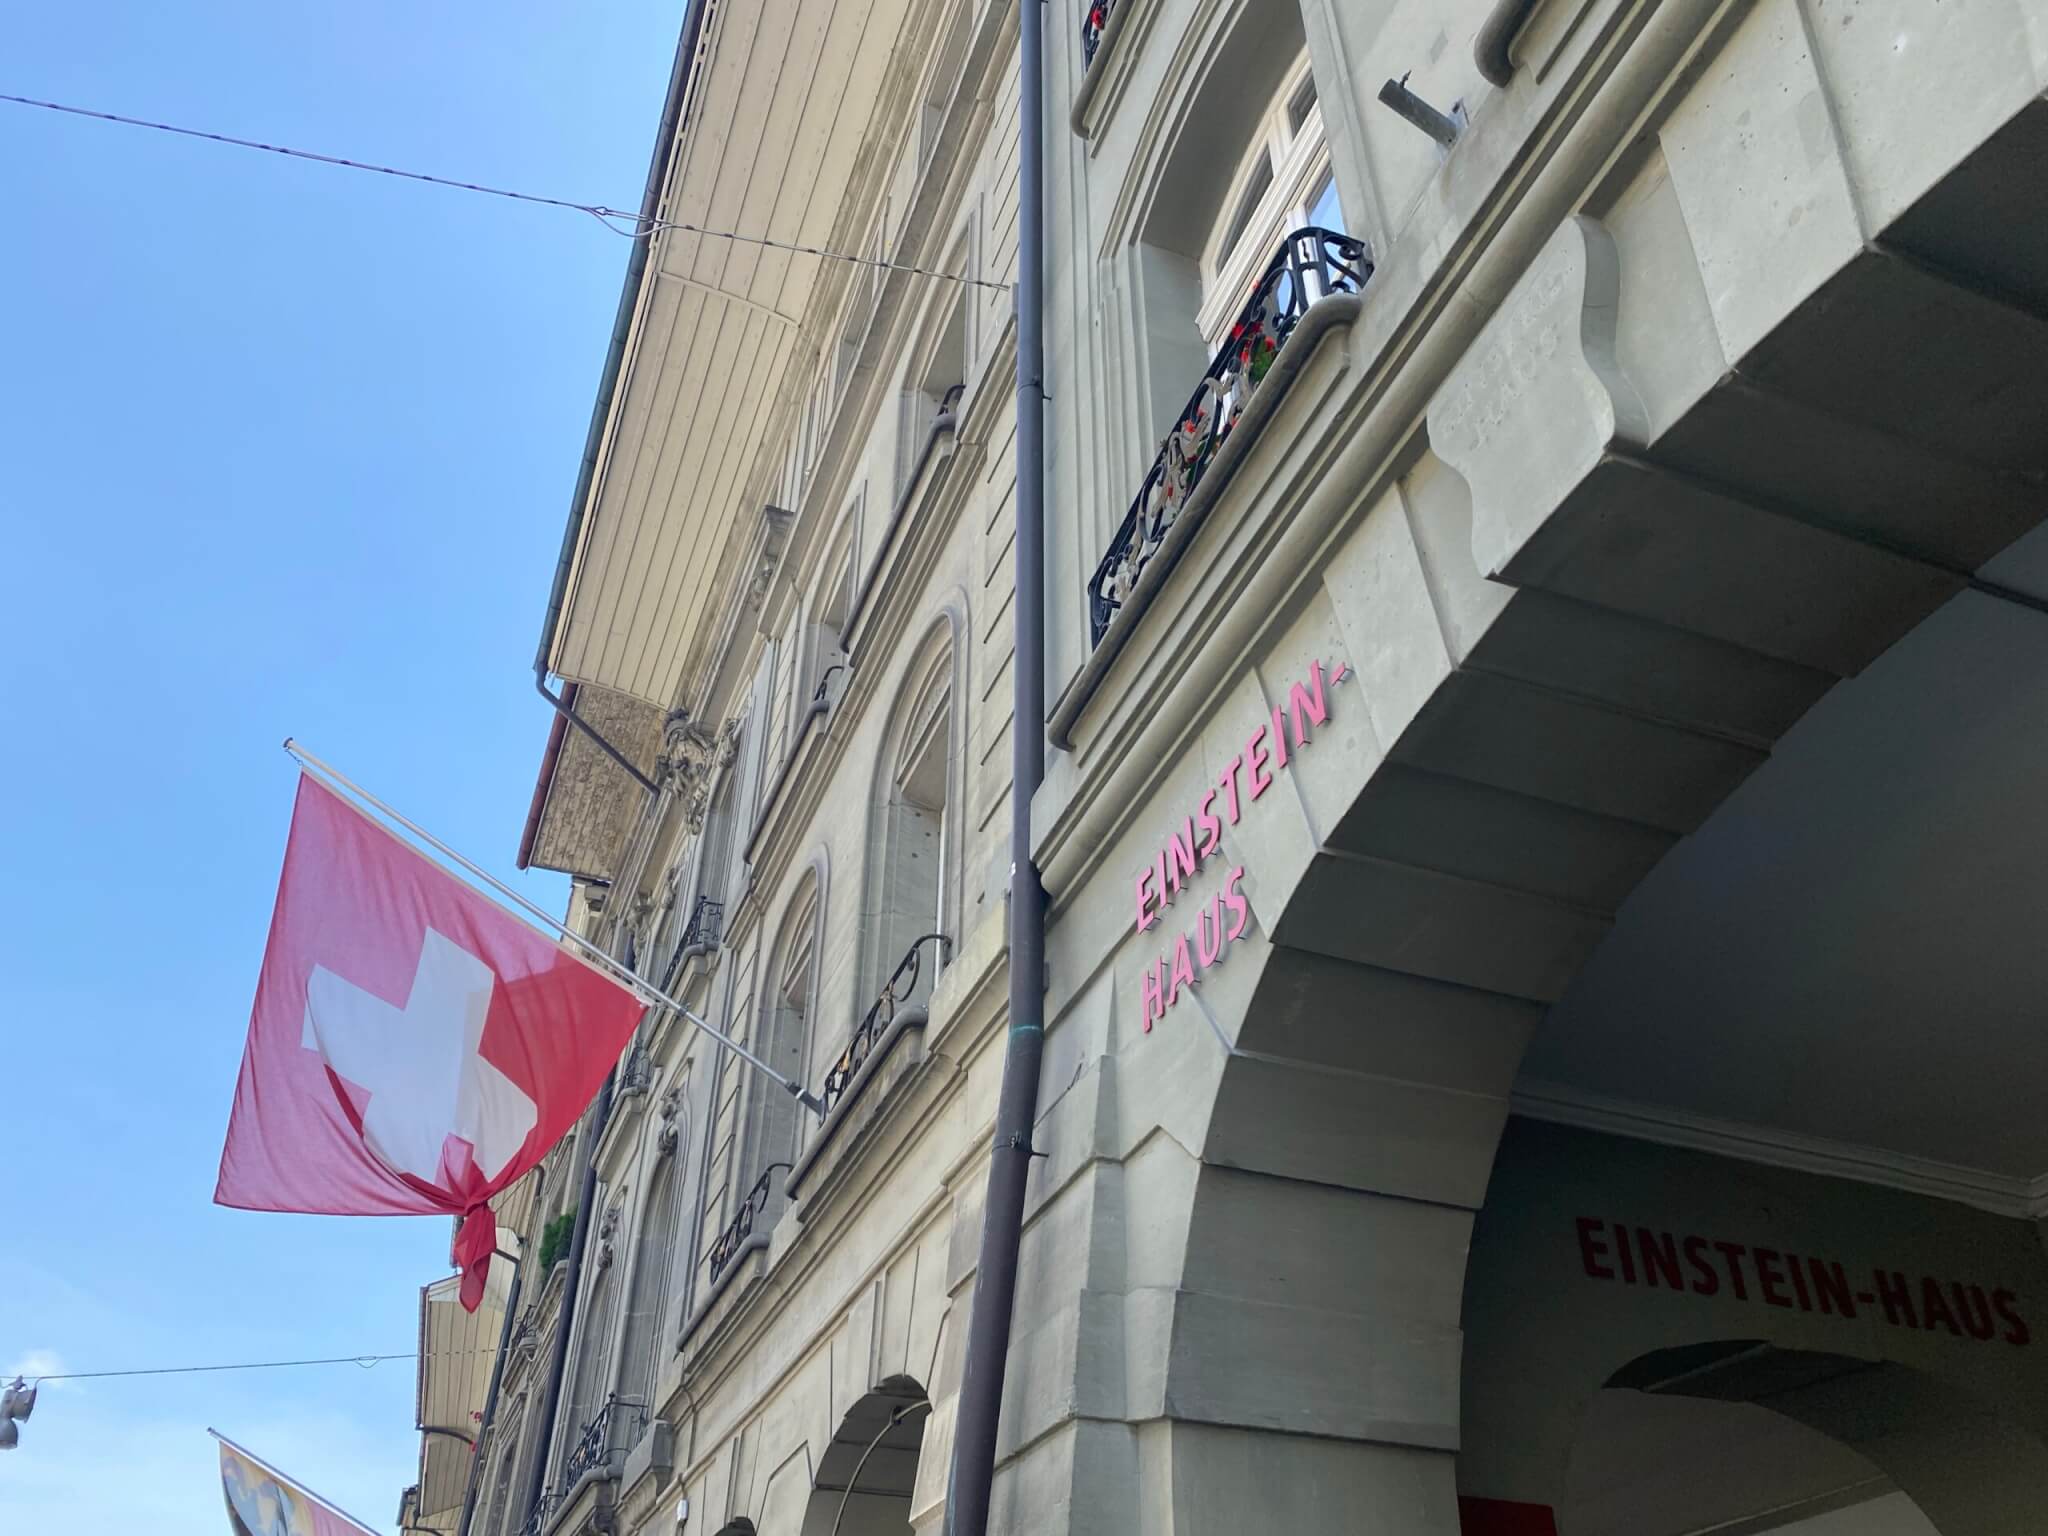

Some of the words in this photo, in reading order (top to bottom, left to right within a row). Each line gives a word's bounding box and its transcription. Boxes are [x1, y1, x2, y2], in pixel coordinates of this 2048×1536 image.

[1136, 659, 1347, 935] EINSTEIN-
[1140, 866, 1249, 1035] HAUS
[1575, 1216, 2031, 1346] EINSTEIN-HAUS
